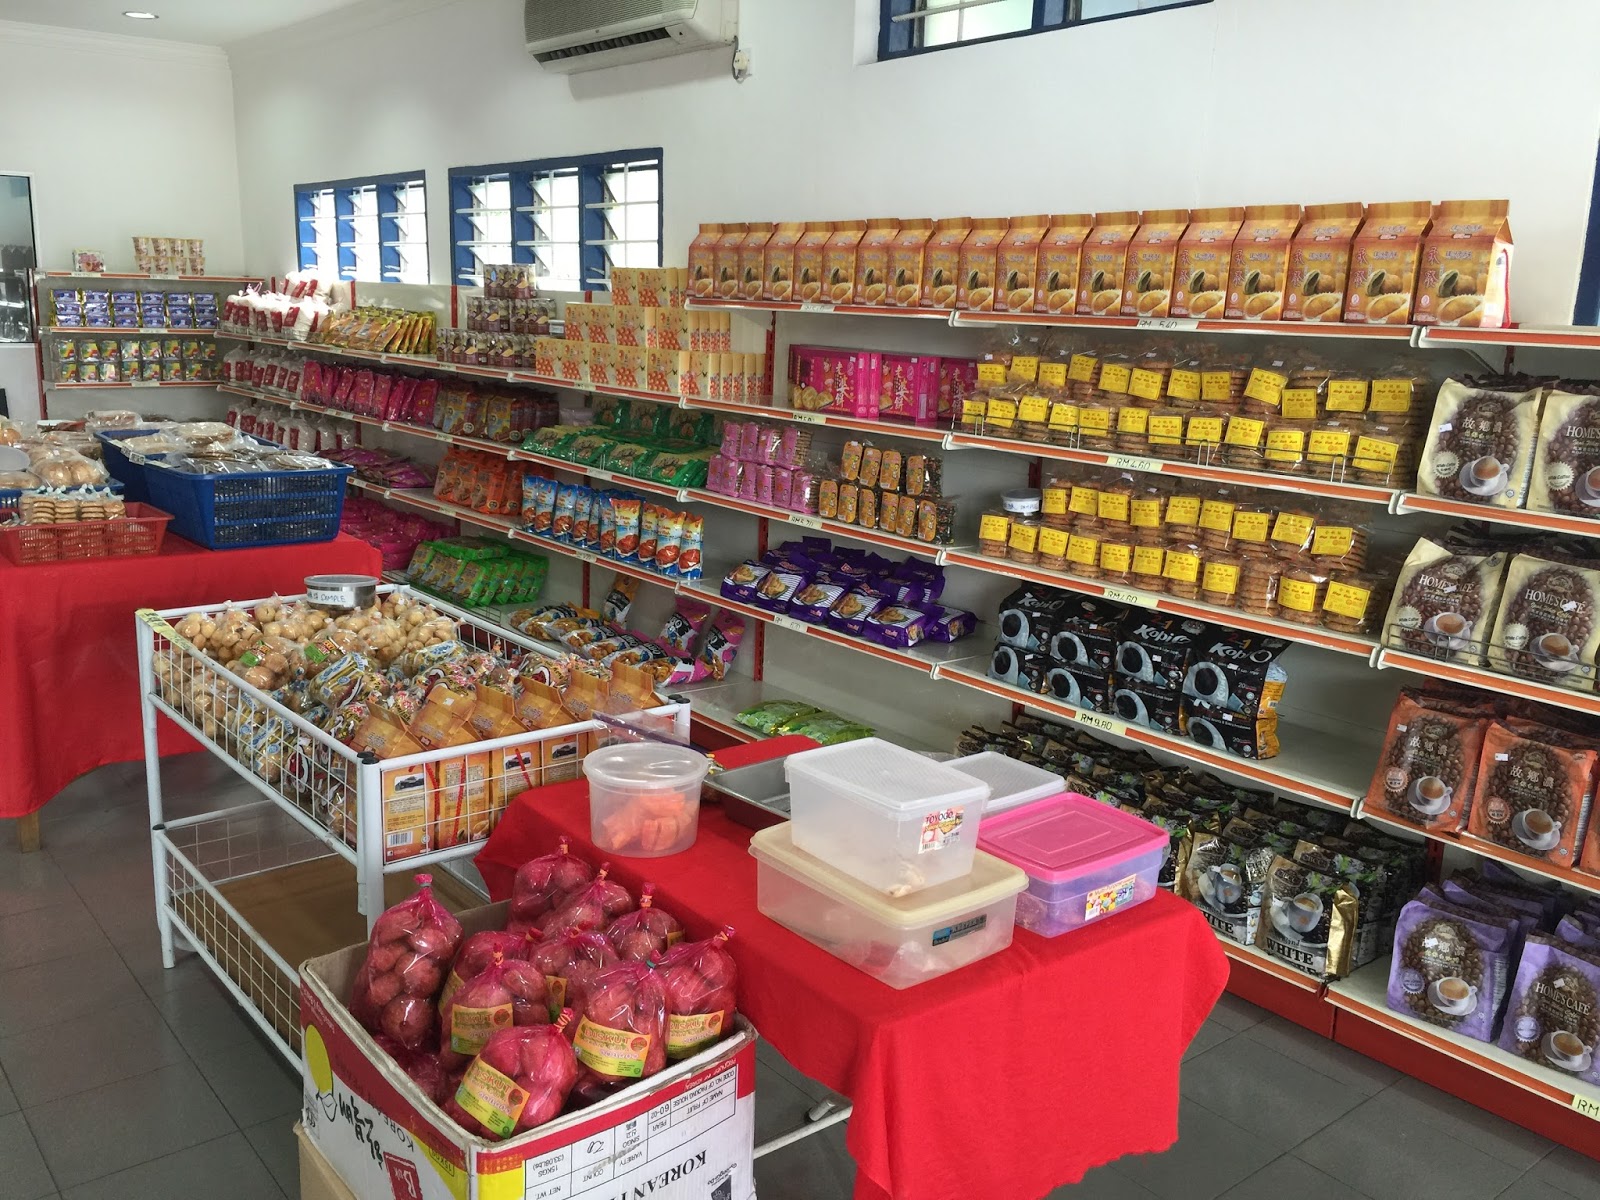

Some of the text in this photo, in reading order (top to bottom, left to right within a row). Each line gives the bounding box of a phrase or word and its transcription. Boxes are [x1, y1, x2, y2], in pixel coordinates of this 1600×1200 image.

[1266, 936, 1314, 966] WHITE
[1422, 937, 1466, 957] 鄉濃
[723, 1069, 735, 1082] CODE
[689, 1085, 708, 1098] PACKING
[708, 1081, 714, 1089] OF
[673, 1095, 689, 1108] HOUSE
[687, 1089, 724, 1114] NAME OF FRUIT
[1577, 1099, 1600, 1116] RM
[650, 1103, 670, 1119] 60-02
[652, 1120, 667, 1132] PEAR
[622, 1135, 640, 1148] SINGO
[619, 1151, 643, 1166] VARIETY
[538, 1165, 559, 1177] 15KGS
[583, 1168, 604, 1182] COUNT
[632, 1150, 707, 1199] KOREAN
[548, 1186, 561, 1196] NET
